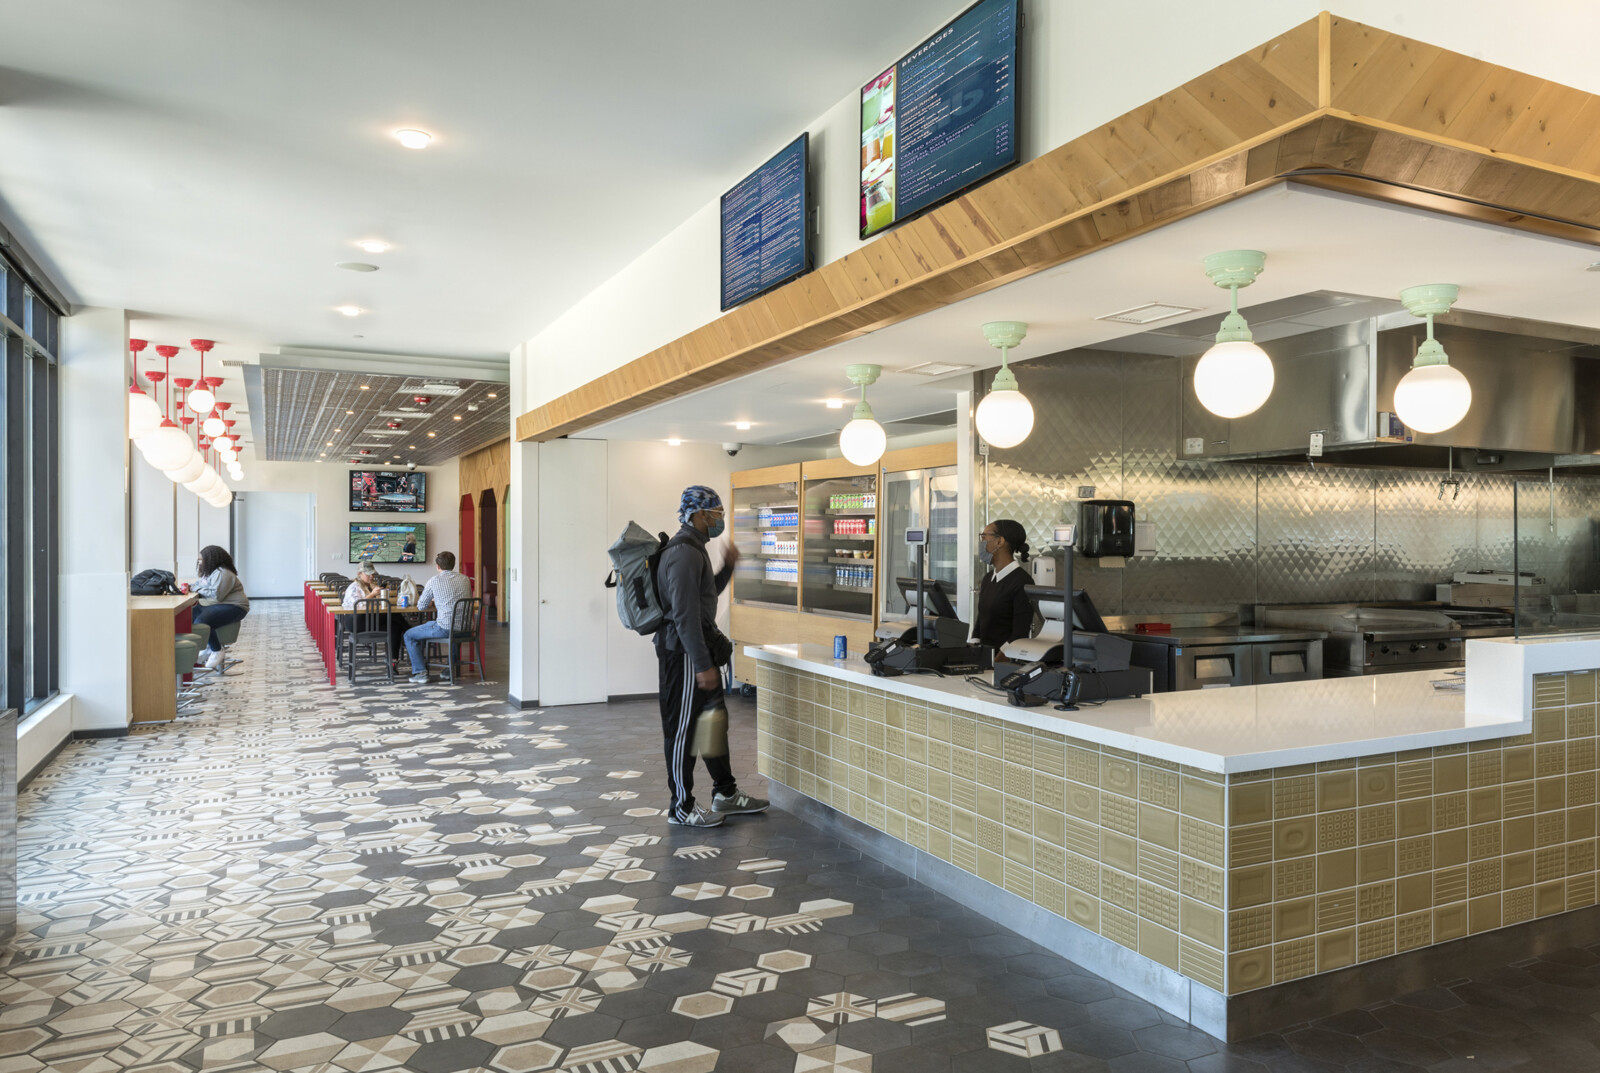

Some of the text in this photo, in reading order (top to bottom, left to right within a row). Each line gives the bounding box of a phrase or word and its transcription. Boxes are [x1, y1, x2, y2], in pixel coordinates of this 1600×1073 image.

[902, 28, 954, 68] BEVERAGES
[901, 144, 924, 160] CRAFTED
[926, 132, 946, 146] SODAS
[736, 796, 749, 807] N
